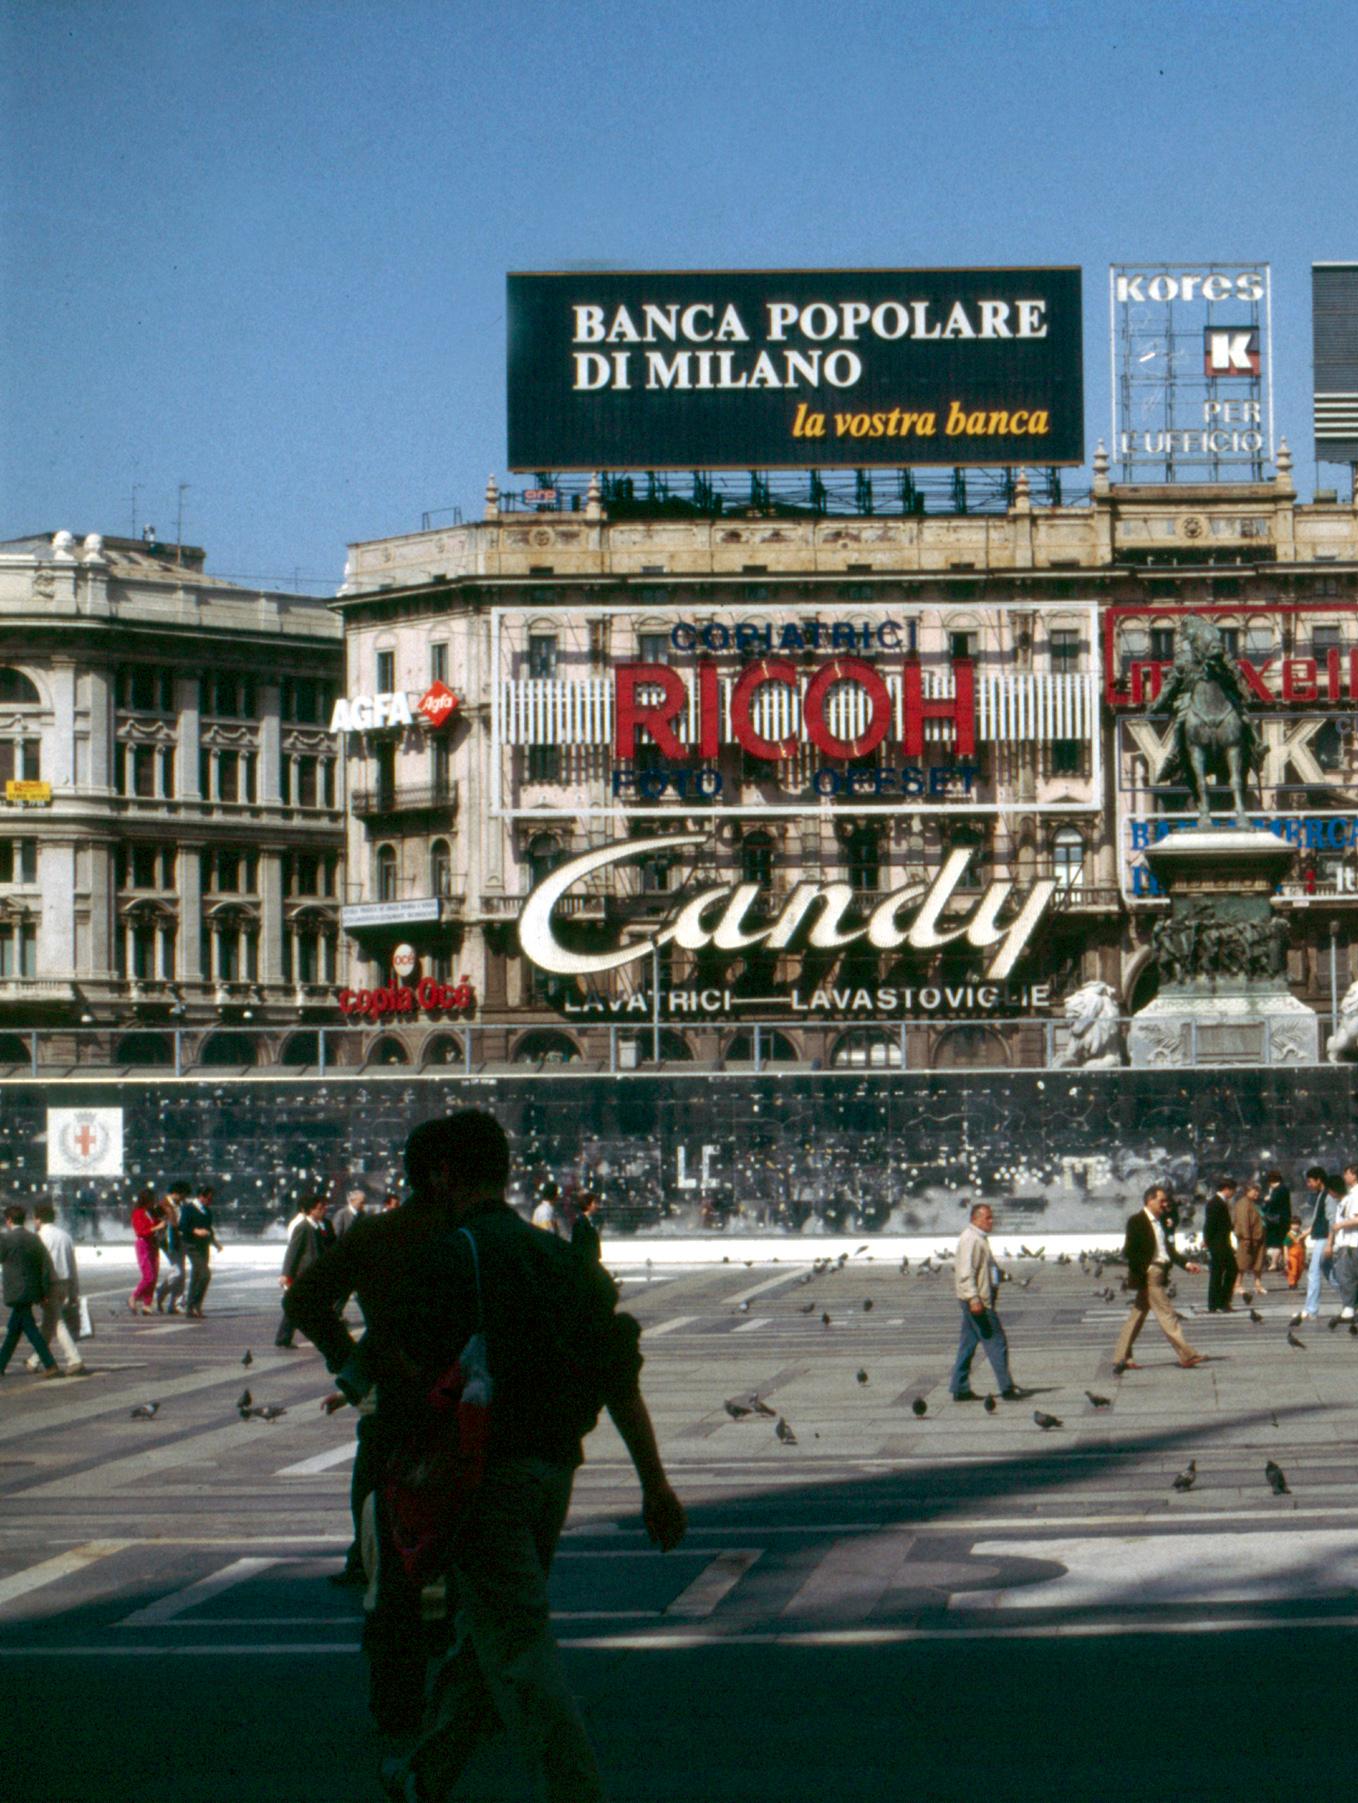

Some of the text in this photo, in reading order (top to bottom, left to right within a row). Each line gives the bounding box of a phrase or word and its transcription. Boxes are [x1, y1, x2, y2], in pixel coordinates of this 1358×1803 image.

[572, 300, 1047, 343] BANCA POPOLARE
[572, 349, 863, 390] DI MILANO
[1211, 332, 1252, 369] K
[792, 402, 1049, 437] la vostra banca
[1203, 400, 1261, 424] PER
[670, 620, 919, 651] COPIATRICI
[329, 691, 413, 733] AGFA
[422, 694, 453, 714] Agfa
[615, 658, 976, 760] RICOH
[1129, 718, 1326, 785] YK
[613, 766, 978, 799] FOTO OFFSET
[518, 831, 1060, 980] Candy
[338, 975, 470, 1021] copia Océ
